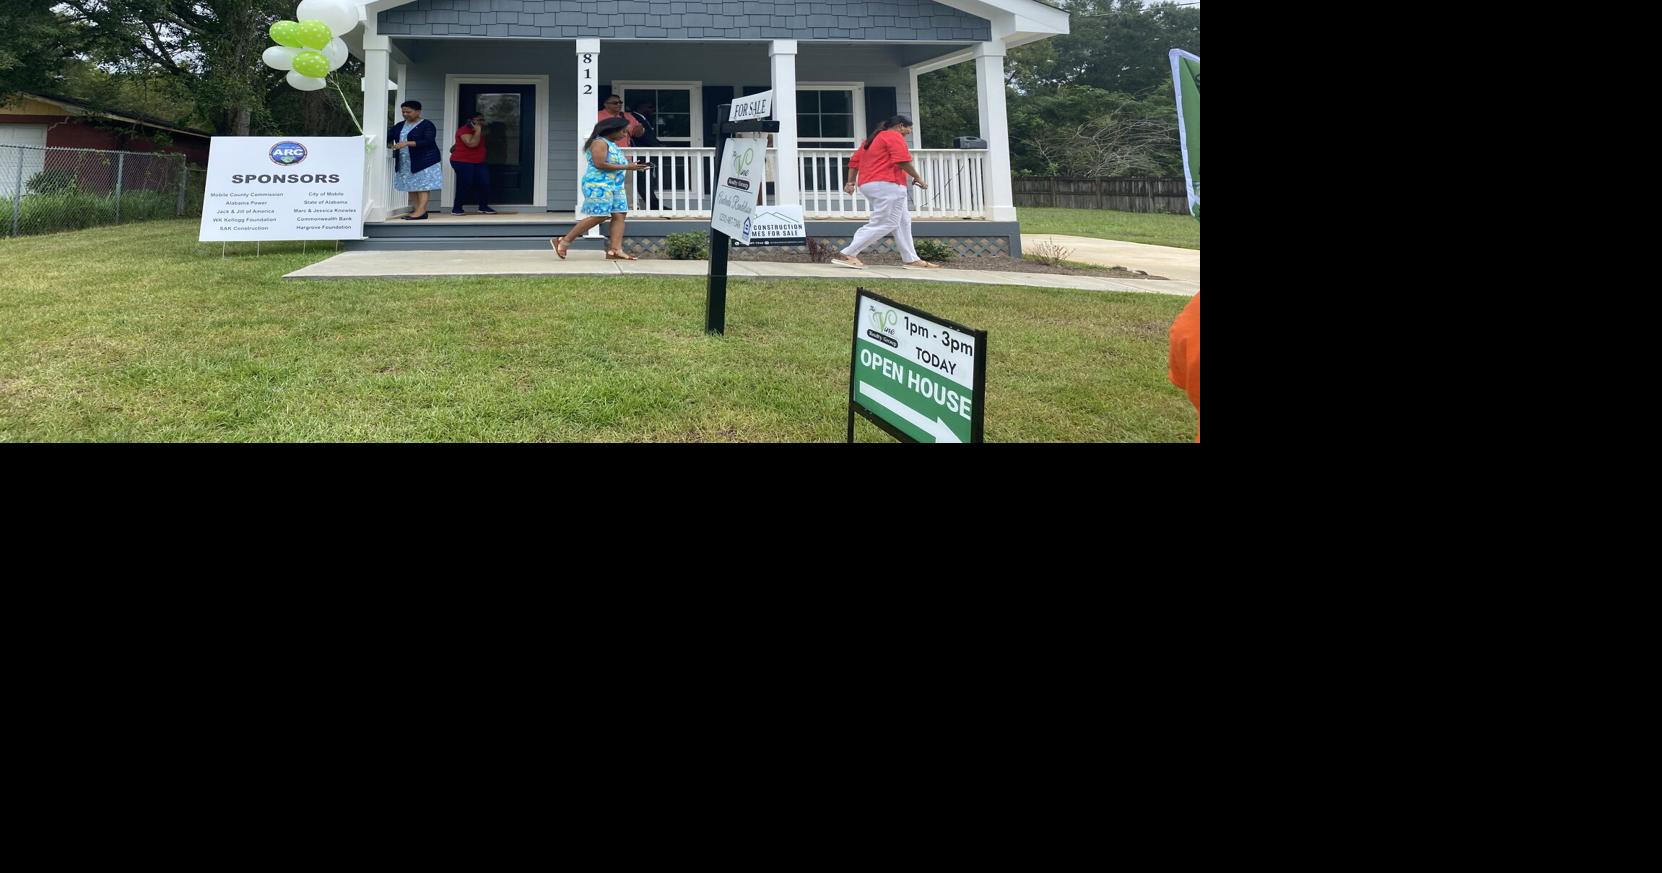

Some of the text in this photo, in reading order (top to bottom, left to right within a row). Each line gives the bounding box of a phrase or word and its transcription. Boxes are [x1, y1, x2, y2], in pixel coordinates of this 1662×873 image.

[583, 52, 592, 95] 812
[734, 100, 766, 118] FOR SALE
[232, 174, 340, 184] SPONSORS
[904, 316, 929, 338] 1pm
[942, 331, 973, 356] 3pm
[916, 346, 957, 376] TODAY
[860, 348, 972, 420] OPEN HOUSE
